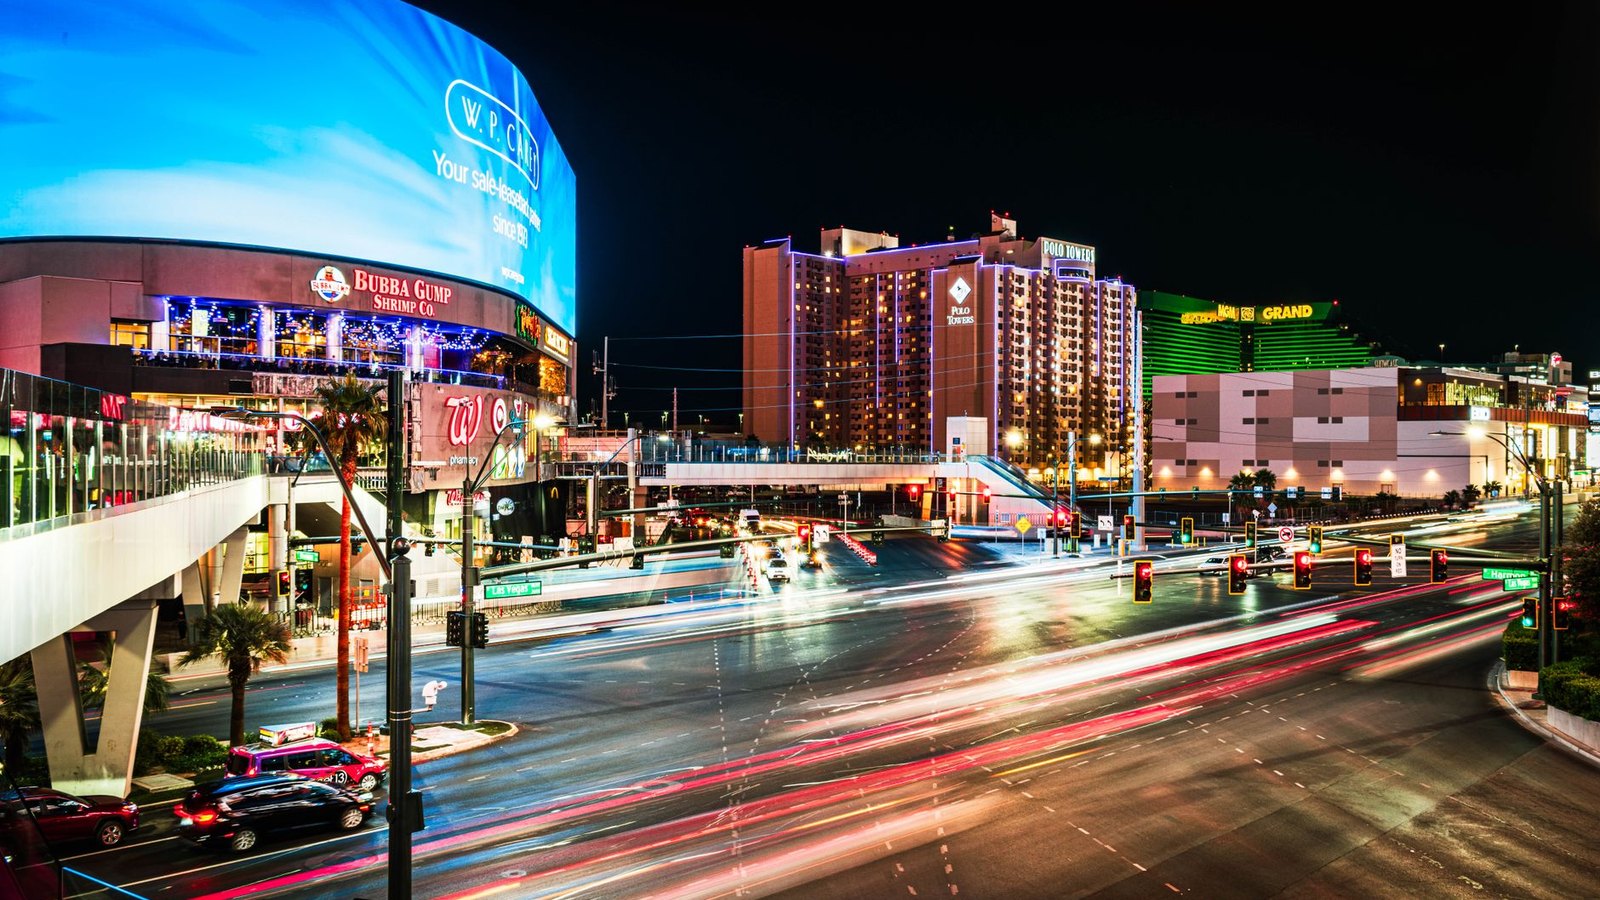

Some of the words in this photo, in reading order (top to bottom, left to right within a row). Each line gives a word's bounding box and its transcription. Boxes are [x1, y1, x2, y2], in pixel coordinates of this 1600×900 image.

[490, 110, 500, 142] P.
[432, 149, 468, 185] Your
[493, 213, 516, 241] since
[1043, 240, 1063, 258] POLO
[1065, 244, 1095, 263] TOWERS
[354, 269, 410, 297] BUBBA
[414, 279, 452, 304] GUMP
[373, 294, 416, 314] SHRIMP
[419, 301, 436, 317] CO.
[951, 306, 970, 316] POLO
[1217, 304, 1236, 319] MGM
[1262, 304, 1313, 320] GRAND
[946, 315, 974, 325] TOWERS
[492, 586, 505, 595] Las
[507, 584, 528, 596] Vegas
